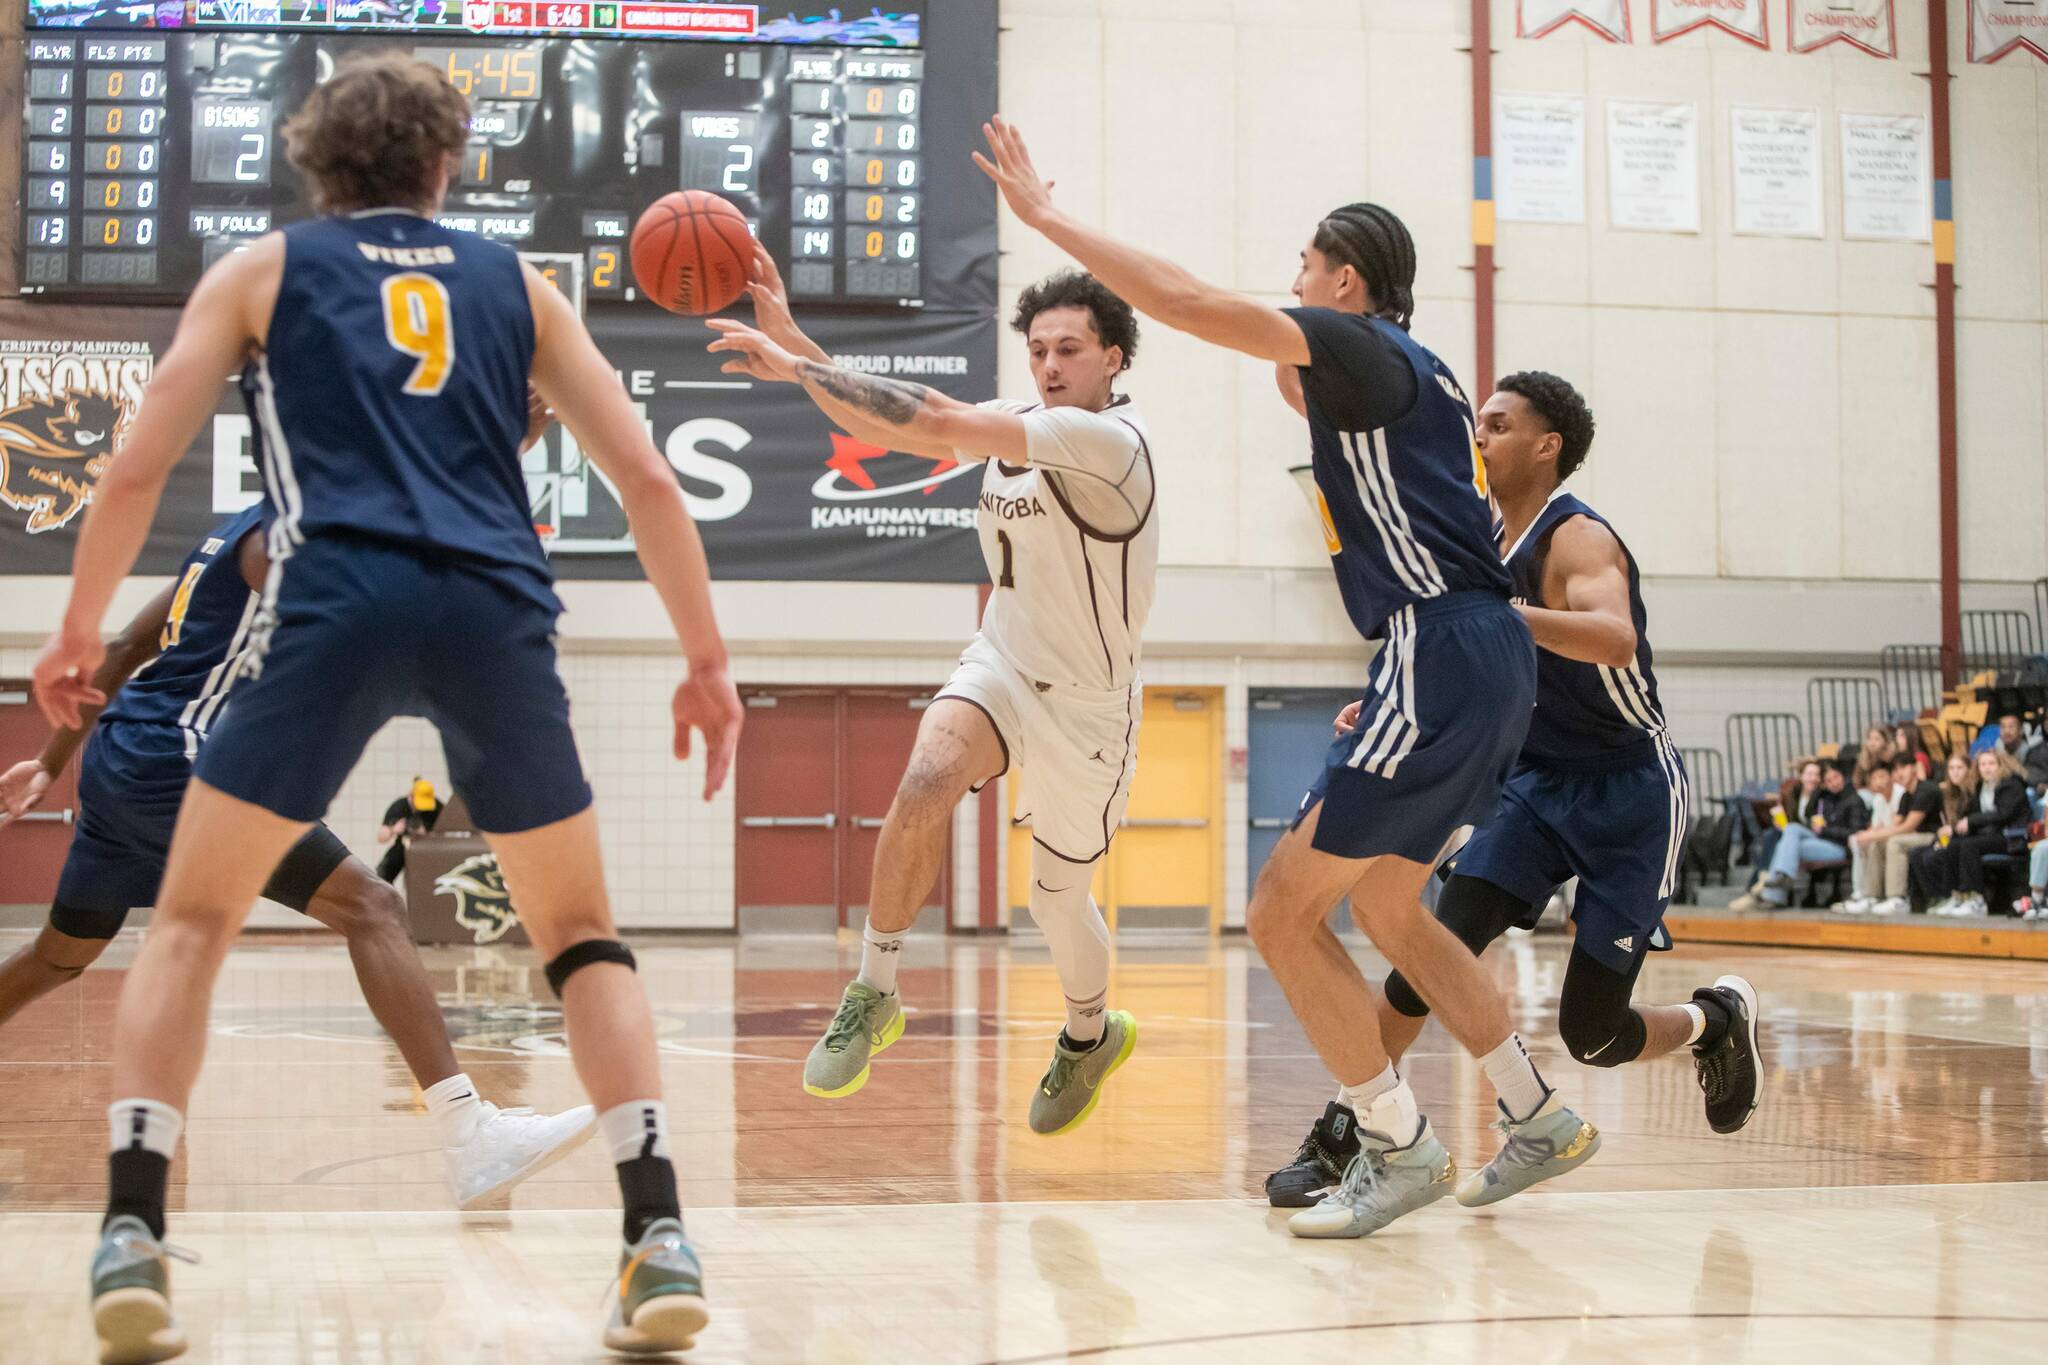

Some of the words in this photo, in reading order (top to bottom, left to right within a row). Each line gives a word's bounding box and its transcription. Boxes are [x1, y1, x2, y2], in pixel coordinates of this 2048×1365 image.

[435, 1, 449, 25] 2
[546, 4, 582, 27] 6:46
[1804, 13, 1878, 29] CHAMPIONS
[1987, 13, 2048, 27] CHAMPION
[34, 45, 71, 59] PLYR
[88, 46, 117, 60] FLS
[124, 46, 152, 61] PTS
[60, 73, 68, 94] 1
[107, 71, 123, 97] 0
[140, 71, 156, 97] 0
[448, 50, 536, 97] 6:45
[820, 88, 829, 110] 1
[867, 87, 883, 113] 0
[897, 88, 915, 114] 0
[51, 107, 67, 133] 2
[106, 108, 122, 133] 0
[138, 108, 155, 134] 0
[204, 106, 260, 127] BISONS
[469, 117, 505, 133] RIOD
[691, 116, 739, 138] VIKES
[811, 122, 829, 147] 2
[897, 124, 915, 150] 0
[50, 145, 65, 170] 6
[105, 144, 121, 170] 0
[138, 144, 154, 171] 0
[235, 133, 264, 181] 2
[478, 151, 487, 181] 1
[722, 144, 753, 191] 2
[812, 158, 829, 182] 9
[866, 159, 883, 184] 0
[897, 160, 915, 186] 0
[50, 181, 65, 205] 9
[105, 181, 121, 208] 0
[137, 181, 154, 208] 0
[803, 193, 829, 220] 10
[866, 195, 883, 221] 0
[897, 196, 915, 222] 2
[40, 218, 64, 244] 13
[103, 218, 120, 245] 0
[136, 218, 152, 245] 0
[220, 216, 267, 232] FOULS
[482, 218, 530, 234] FOULS
[594, 220, 625, 237] TOL
[356, 241, 456, 267] VIKES
[803, 231, 829, 255] 14
[866, 231, 883, 257] 0
[897, 231, 915, 258] 0
[593, 252, 616, 287] 2
[0, 340, 51, 353] ERSITY
[51, 340, 72, 353] OF
[72, 340, 150, 354] MANITOBA
[380, 271, 456, 397] 9
[832, 354, 891, 373] PROUD
[893, 355, 968, 375] PARTNER
[0, 354, 153, 410] ISONS
[978, 491, 1047, 520] NITOBA
[866, 525, 926, 538] SPORTS
[997, 528, 1015, 589] 1
